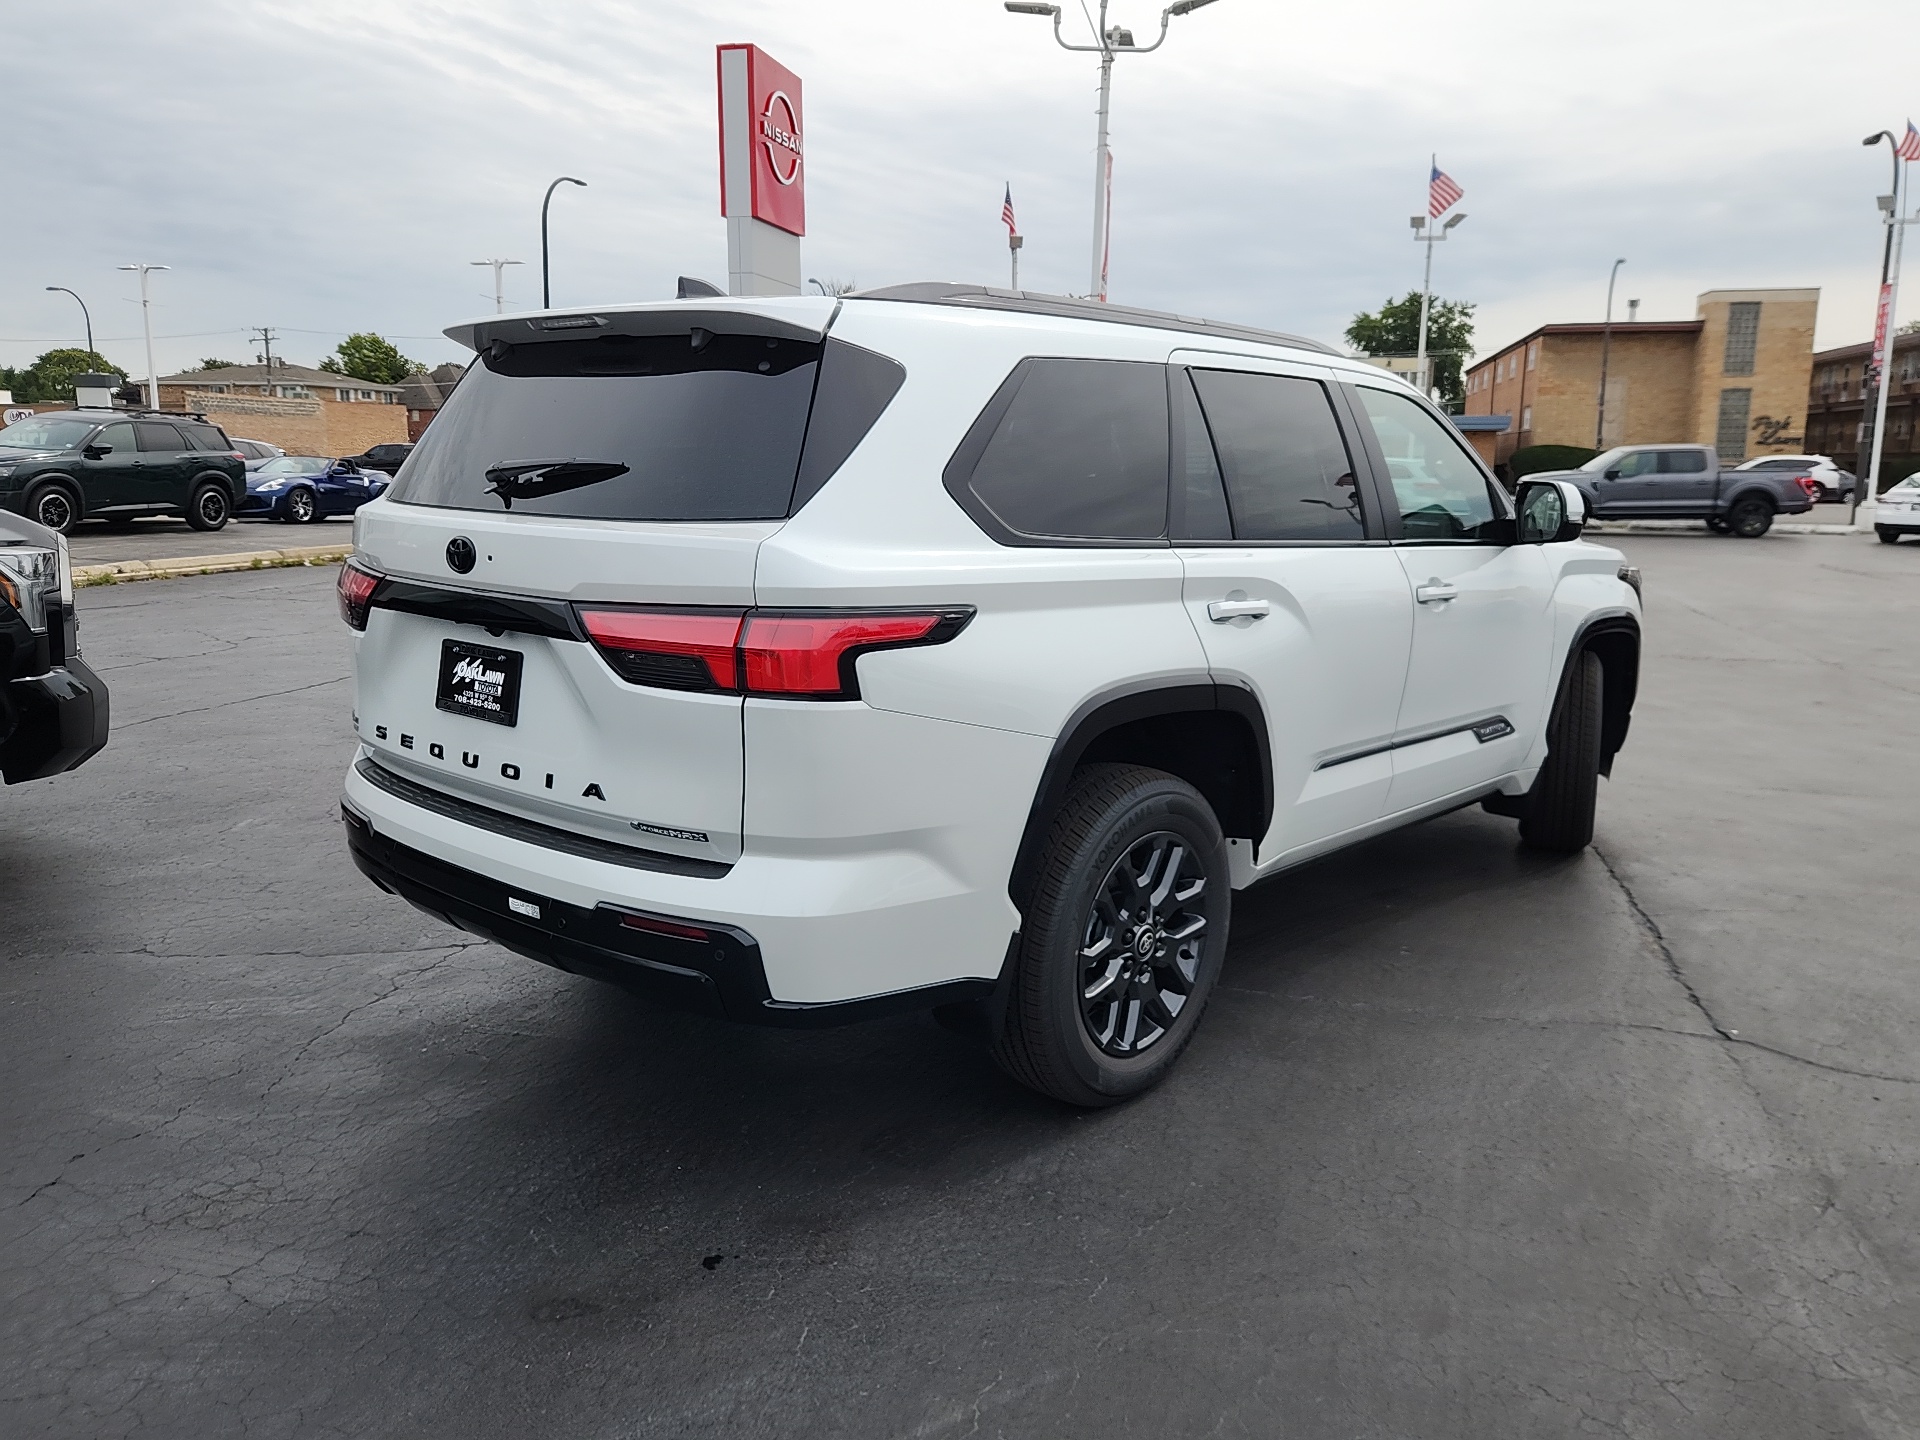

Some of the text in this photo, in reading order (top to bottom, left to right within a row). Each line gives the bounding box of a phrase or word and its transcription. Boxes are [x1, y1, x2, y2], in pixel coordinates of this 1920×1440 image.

[764, 120, 802, 156] NISSAN
[454, 694, 501, 712] 708-423-5200
[375, 725, 606, 801] SEQUOIA
[1091, 804, 1153, 870] YOKOHAMA
